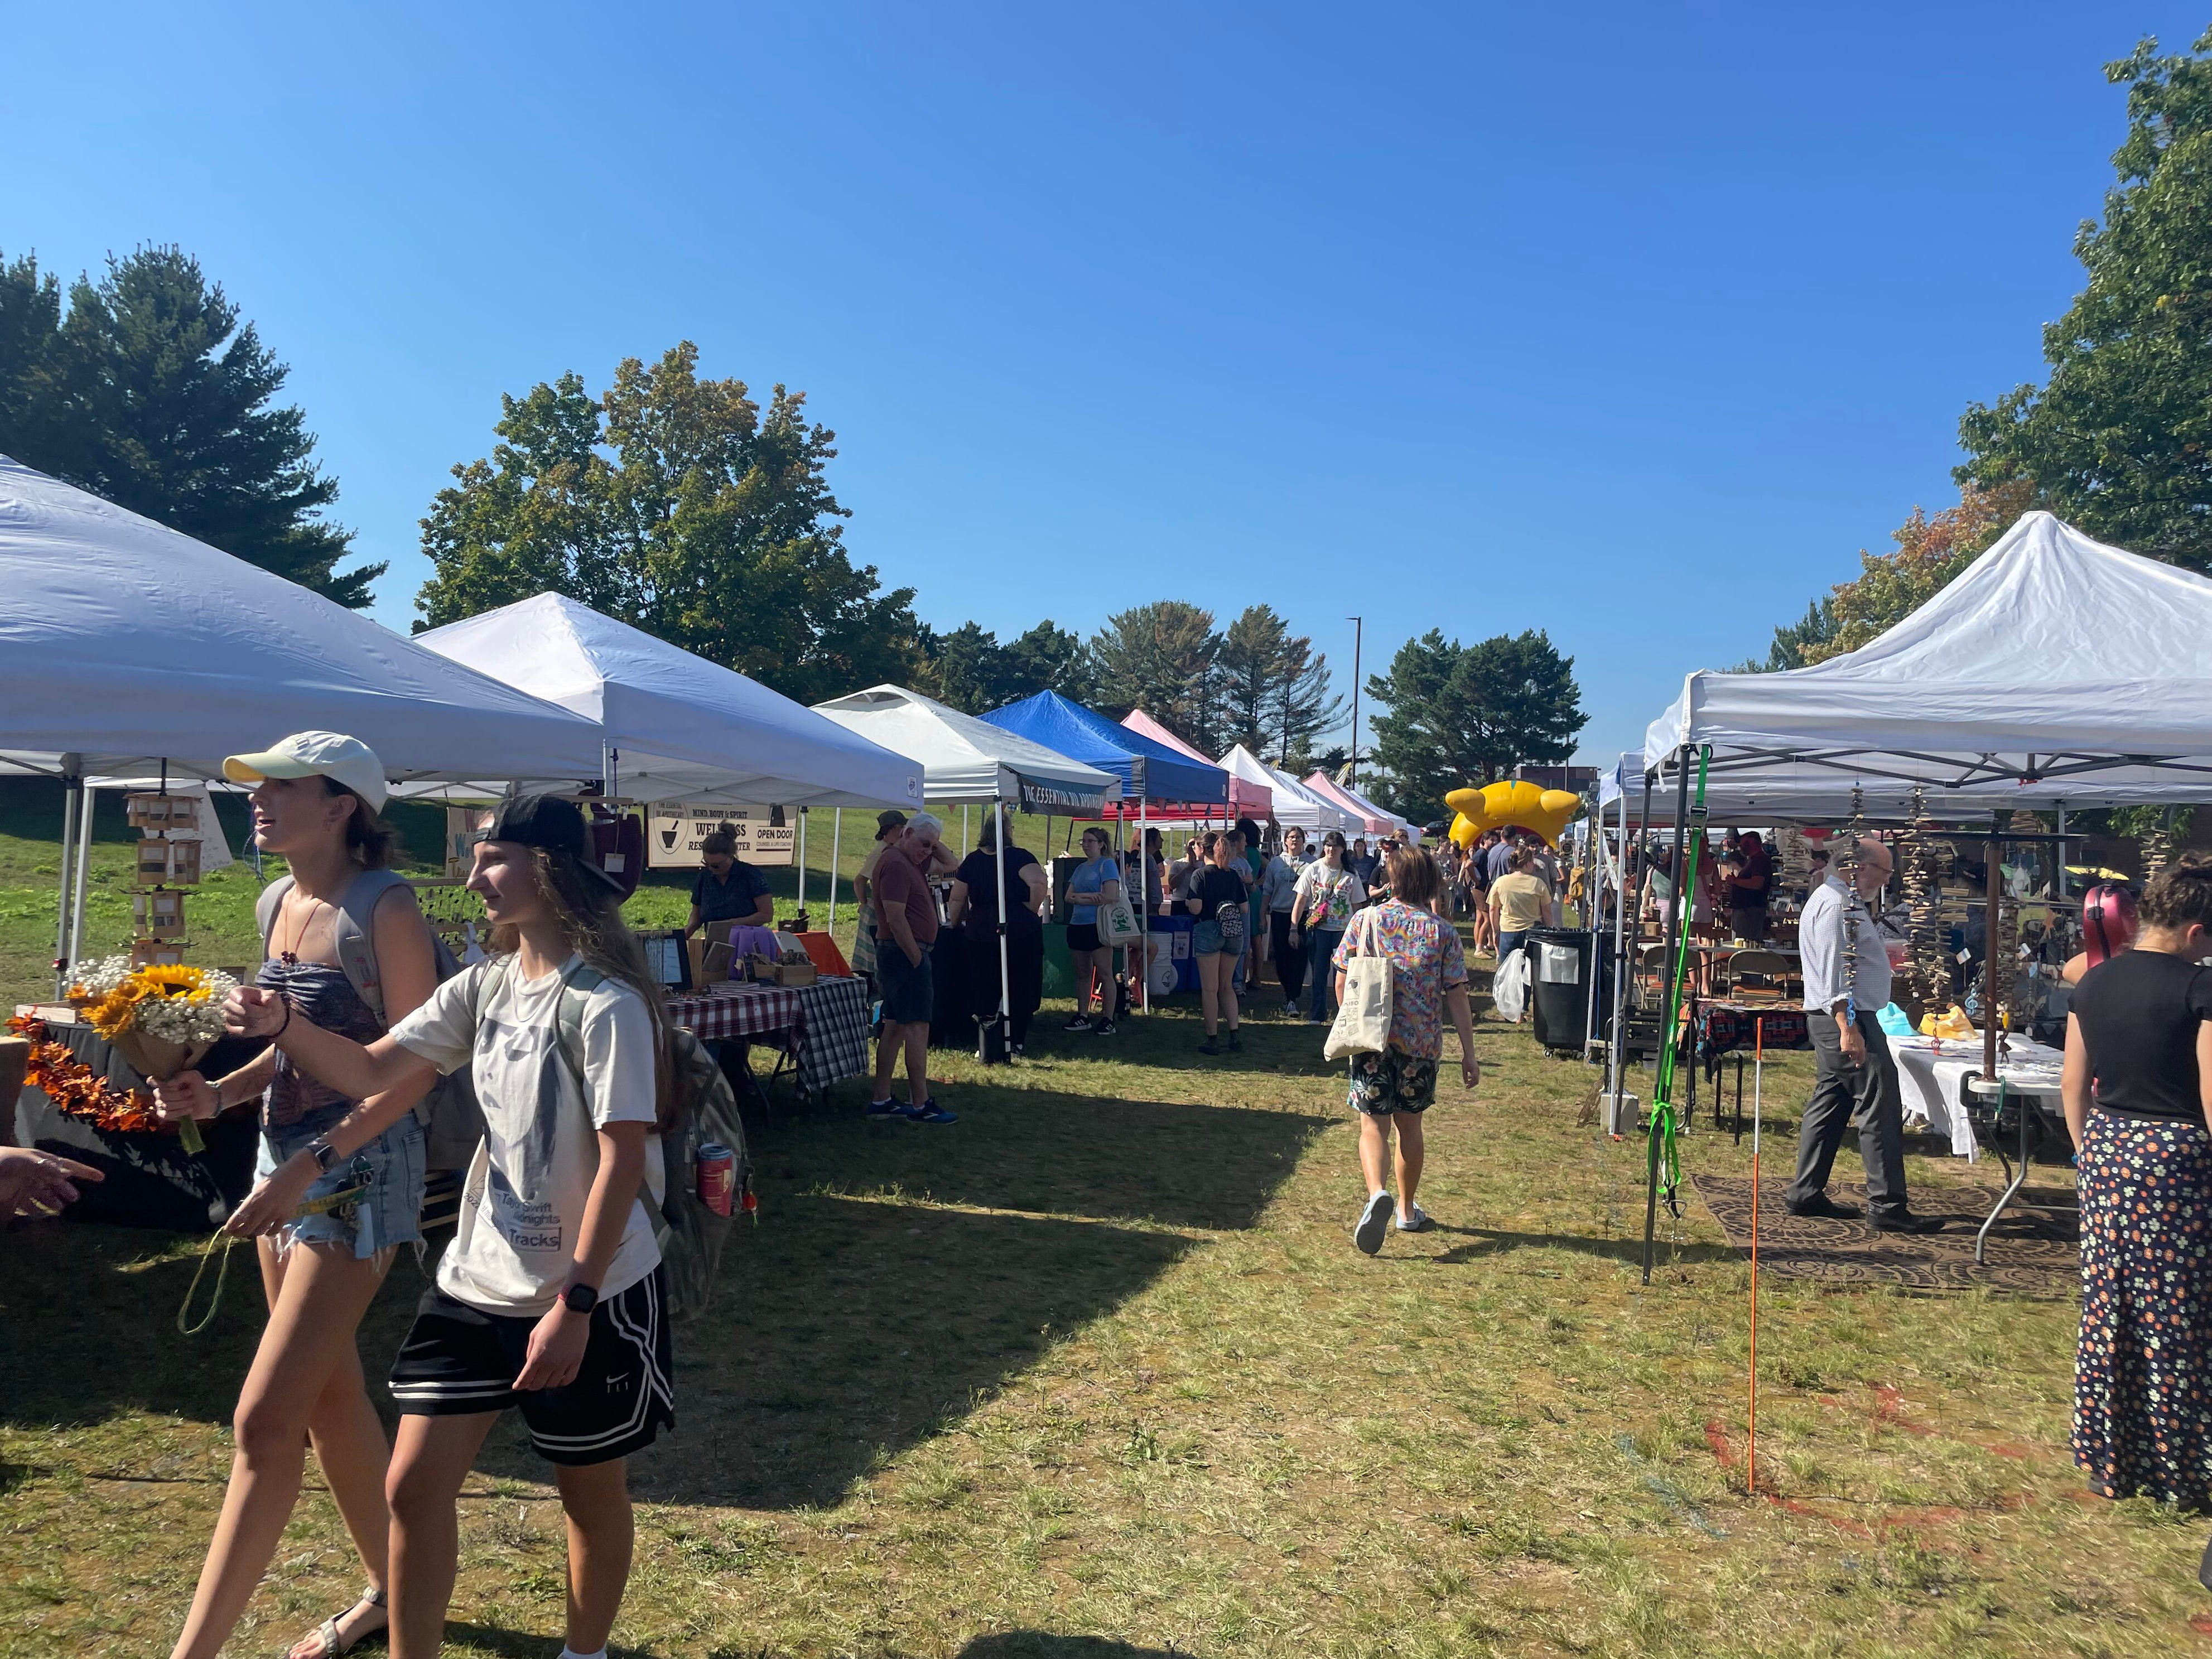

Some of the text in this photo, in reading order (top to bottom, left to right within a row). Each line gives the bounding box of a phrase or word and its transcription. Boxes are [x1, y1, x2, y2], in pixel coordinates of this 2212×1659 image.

[1024, 785, 1035, 802] THE
[1036, 787, 1070, 806] ESSENTIAL
[1068, 791, 1080, 807] OIL
[692, 809, 710, 818] MIND,
[710, 809, 724, 818] BODY
[730, 811, 748, 819] SPIRIT
[695, 822, 746, 836] WELSS
[758, 829, 793, 839] OPEN DOOR
[522, 1200, 552, 1212] Swift
[508, 1228, 559, 1247] Tracks
